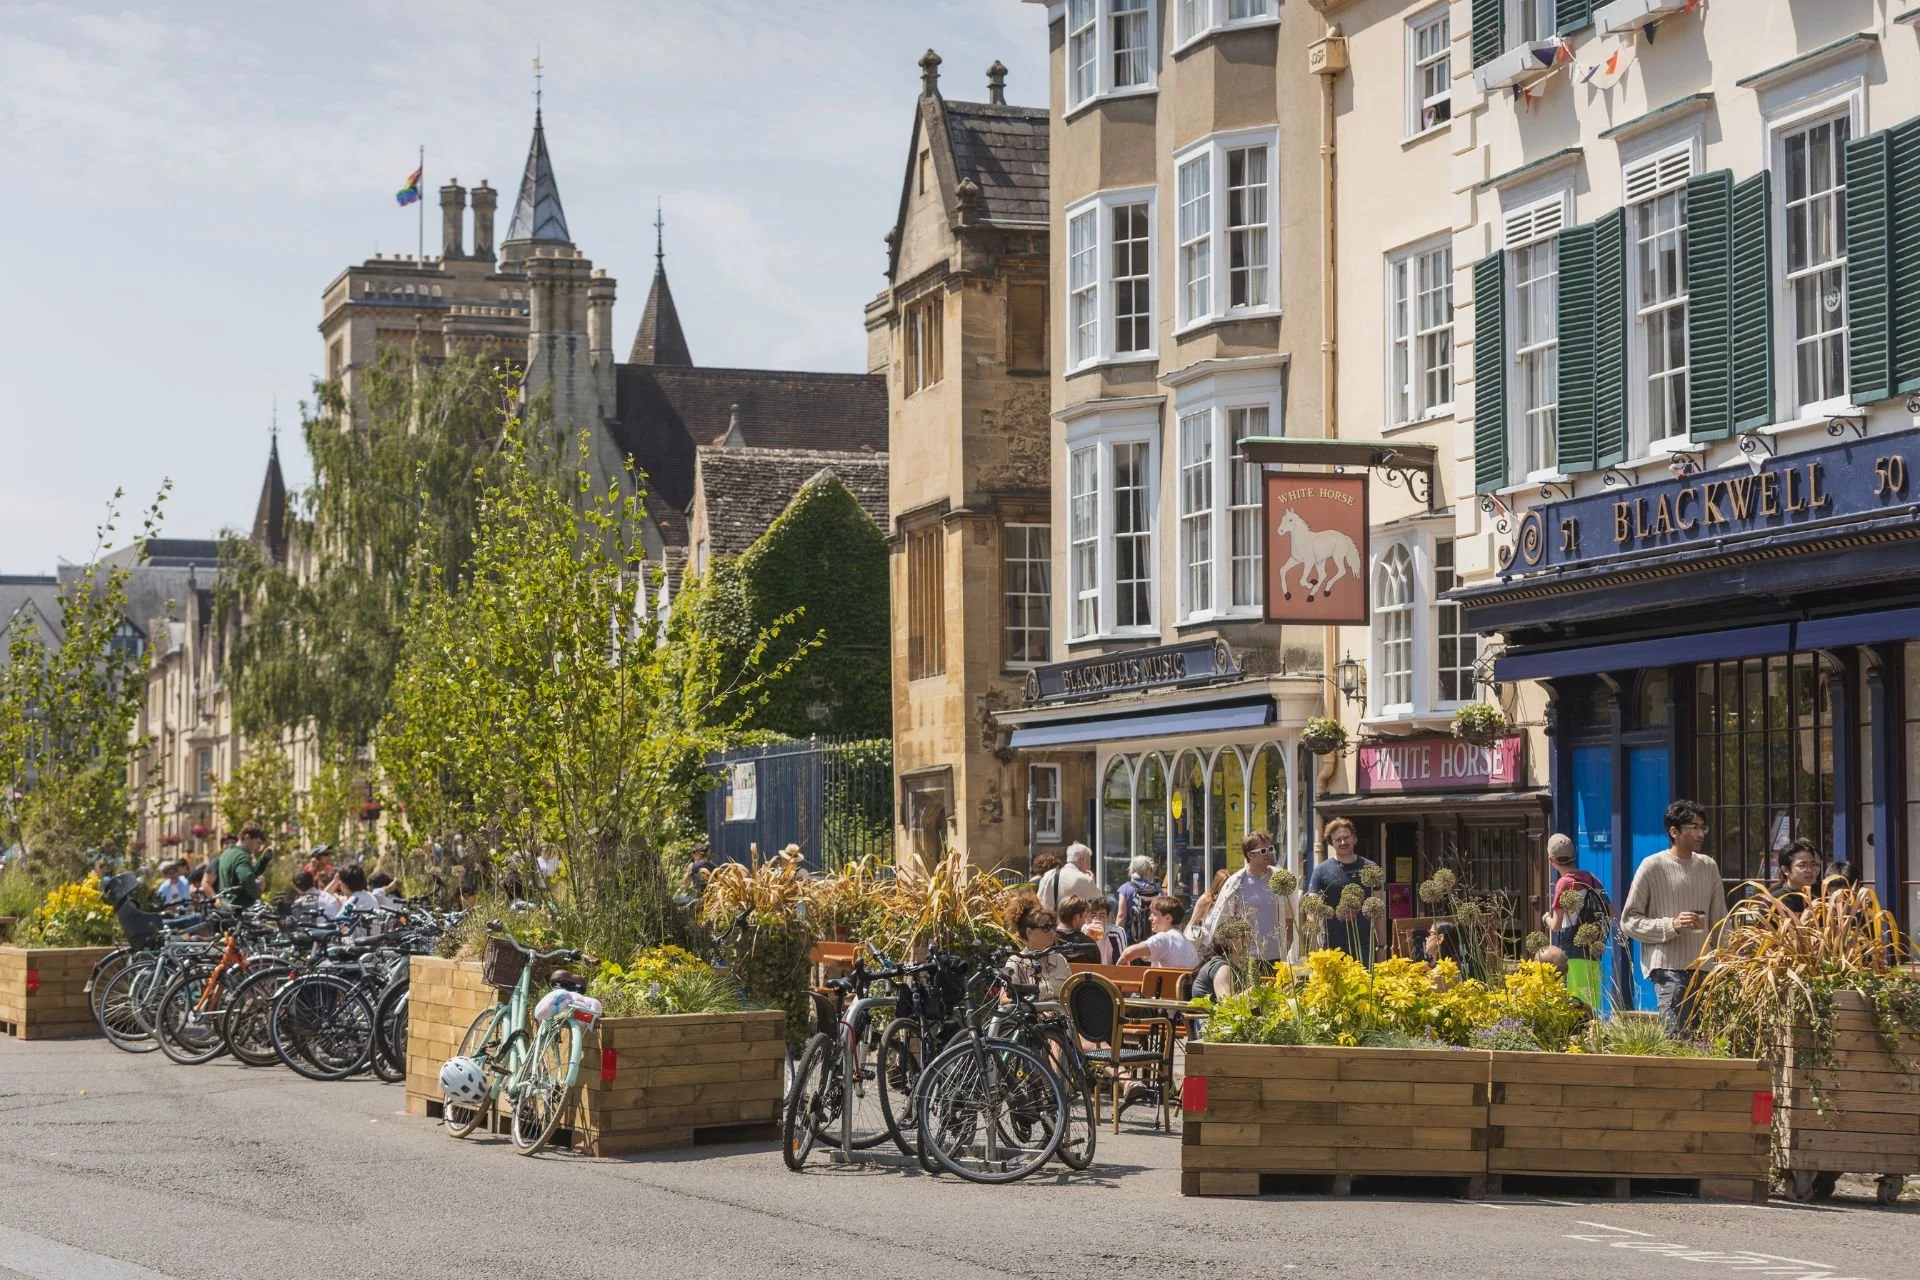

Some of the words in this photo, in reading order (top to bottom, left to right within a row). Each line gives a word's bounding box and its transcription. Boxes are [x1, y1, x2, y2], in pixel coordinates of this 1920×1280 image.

[1278, 487, 1315, 504] WHITE
[1319, 487, 1355, 506] HORSE
[1560, 517, 1579, 551] 51
[1612, 463, 1826, 543] BLACKWELL
[1874, 455, 1905, 496] 50
[1061, 658, 1140, 690] BLACKWELL'S
[1143, 652, 1185, 679] MUSIC
[1376, 745, 1431, 781] WHITE
[1440, 740, 1504, 778] HORSE
